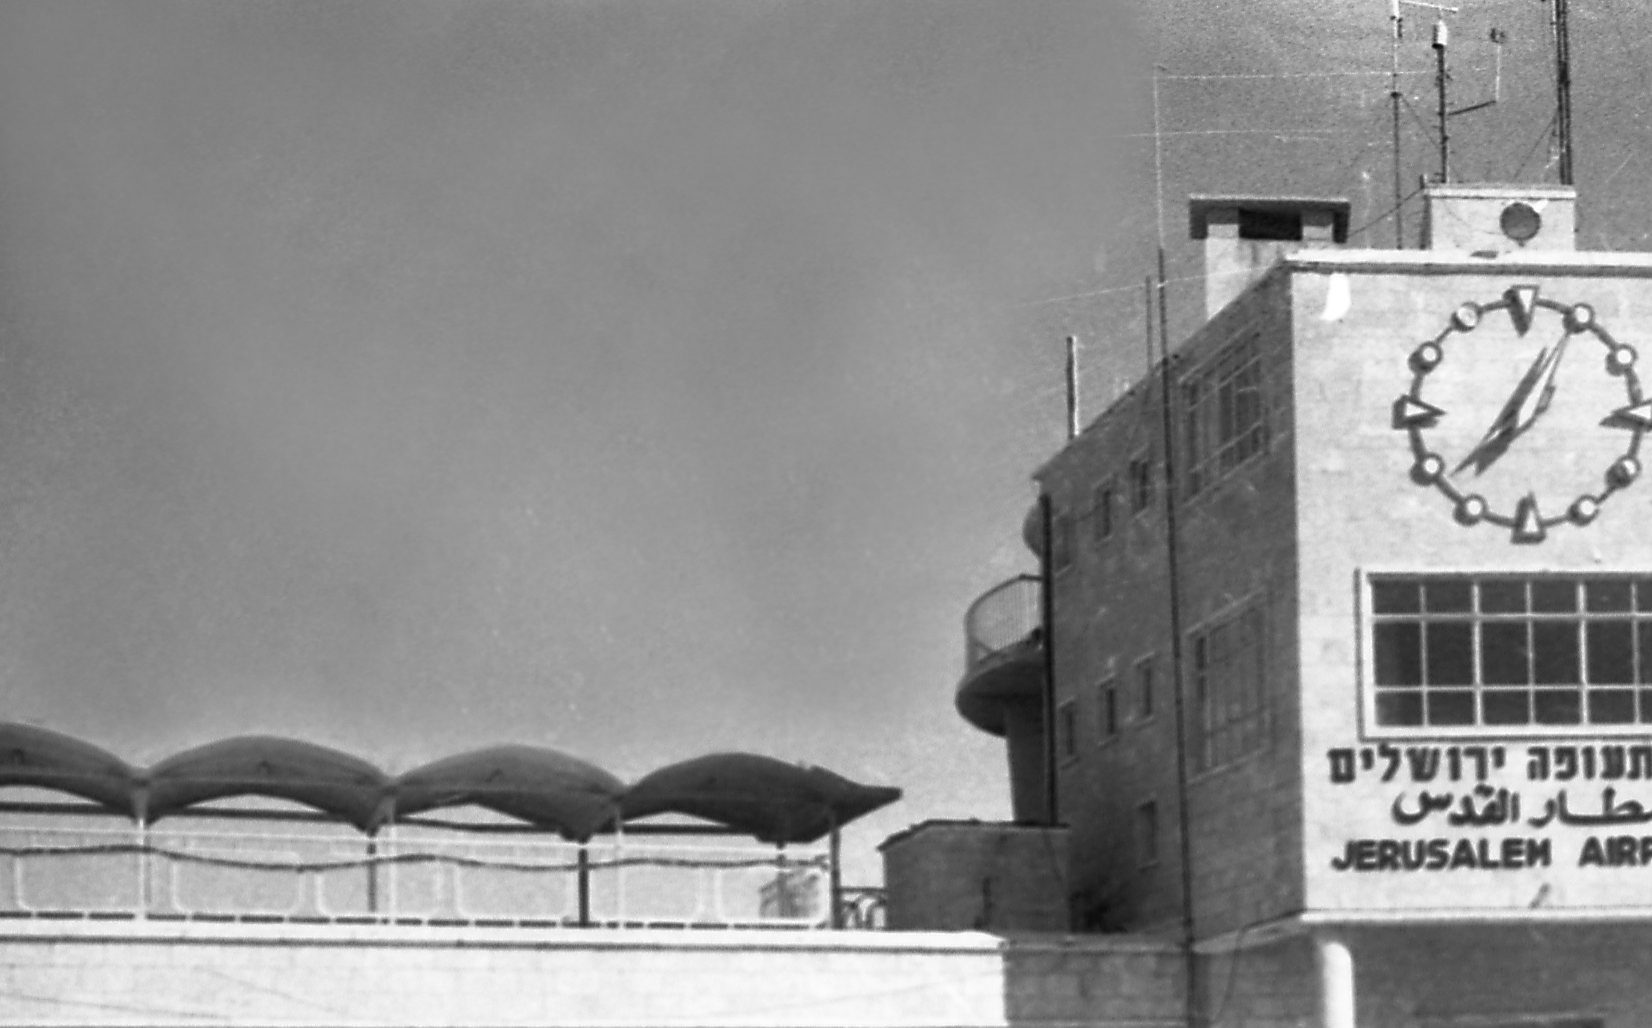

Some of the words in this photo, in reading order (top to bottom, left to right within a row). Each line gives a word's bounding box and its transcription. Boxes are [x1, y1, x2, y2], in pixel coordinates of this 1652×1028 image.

[1327, 742, 1507, 783] ירושלים
[1392, 783, 1520, 826] القدس
[1331, 837, 1551, 871] JERUSALEM
